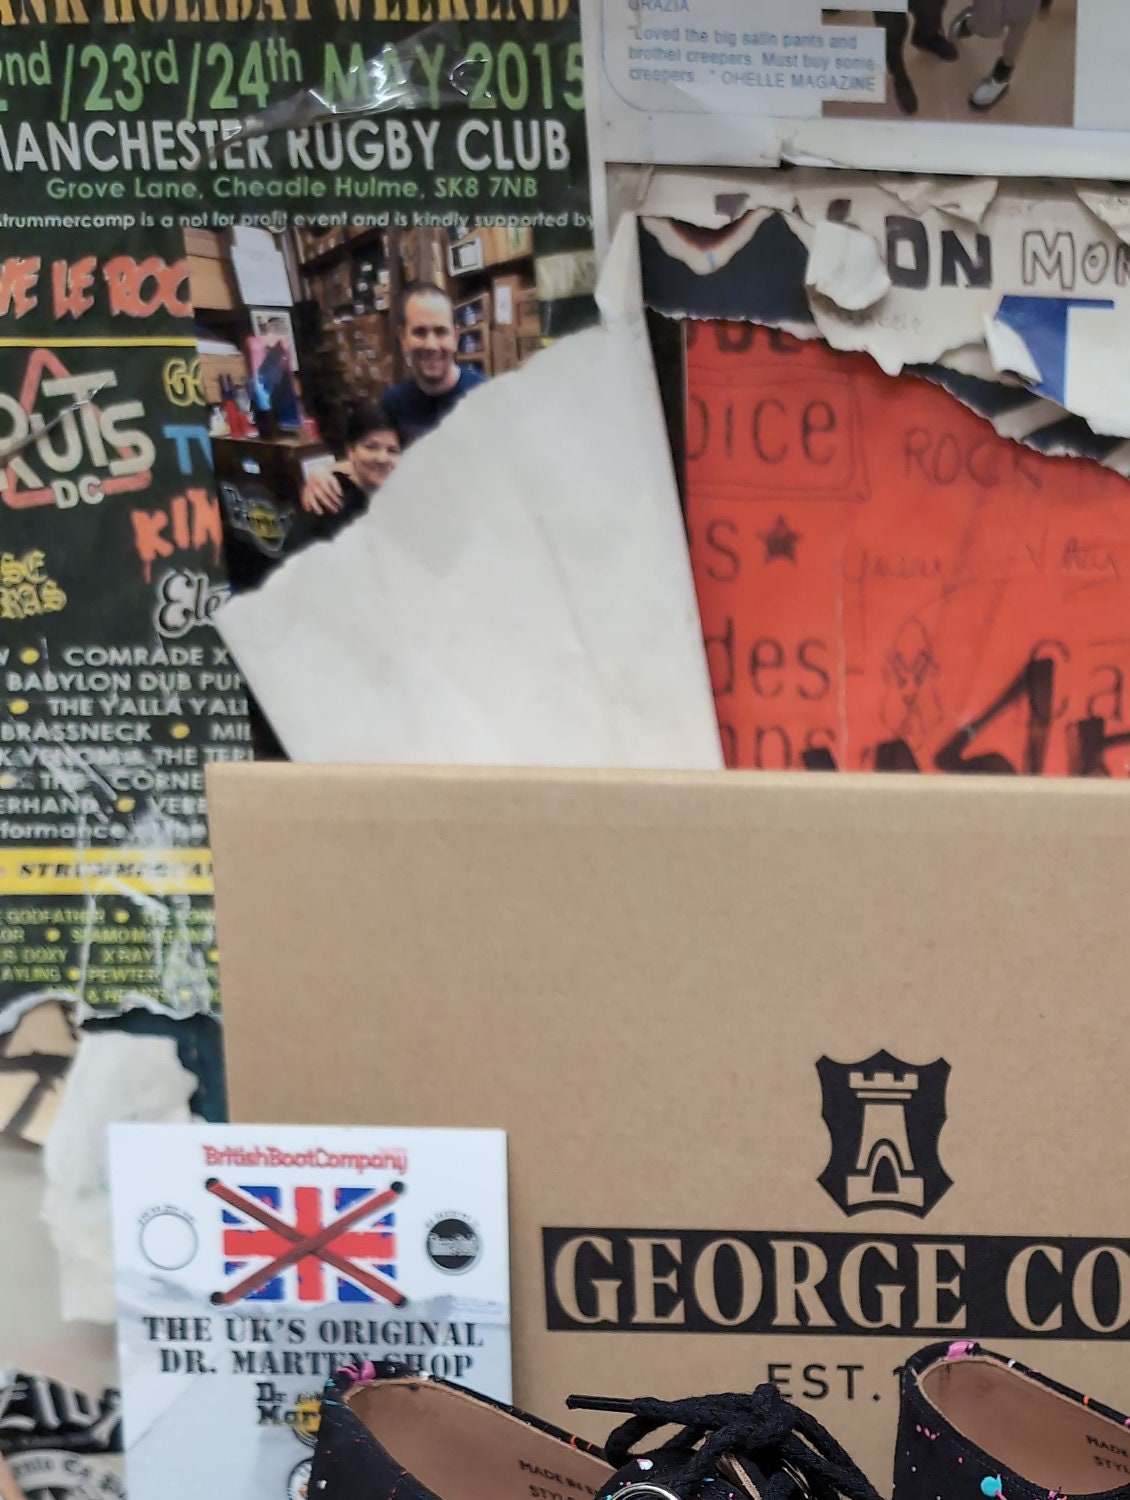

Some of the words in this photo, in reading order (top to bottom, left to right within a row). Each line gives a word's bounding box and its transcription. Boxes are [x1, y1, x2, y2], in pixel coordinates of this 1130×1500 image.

[685, 28, 709, 44] the
[713, 30, 737, 47] big
[742, 32, 778, 47] satin
[783, 34, 825, 50] pants
[830, 36, 857, 50] and
[628, 46, 681, 61] brothel
[762, 52, 798, 68] Must
[803, 54, 829, 71] buy
[835, 55, 876, 70] some
[462, 42, 586, 110] 2015
[791, 74, 876, 92] MAGAZINE
[288, 119, 440, 170] RUGBY
[457, 119, 570, 171] CLUB
[46, 177, 125, 199] Grove
[135, 177, 203, 200] Lane,
[213, 176, 326, 198] Cheadle
[336, 177, 425, 200] Hulme,
[435, 177, 478, 198] SK8
[489, 177, 538, 198] 7NB
[141, 212, 155, 227] is
[161, 216, 174, 228] a
[180, 213, 208, 228] not
[212, 211, 235, 227] for
[294, 212, 348, 227] event
[353, 211, 392, 226] and
[395, 211, 408, 226] is
[413, 211, 469, 230] kindly
[475, 212, 568, 230] supported
[52, 256, 97, 319] LE
[52, 474, 104, 510] DC
[62, 648, 204, 667] COMRADE
[6, 672, 132, 692] BABYLON
[139, 671, 193, 692] DUB
[48, 699, 95, 717] THE
[100, 698, 183, 717] YALLA
[0, 722, 152, 743] BRASSNECK
[153, 748, 199, 767] THE
[553, 1236, 968, 1330] GEORGE
[142, 1316, 212, 1342] THE
[225, 1316, 306, 1344] UK'S
[319, 1320, 484, 1347] ORIGINAL
[160, 1349, 218, 1374] DR.
